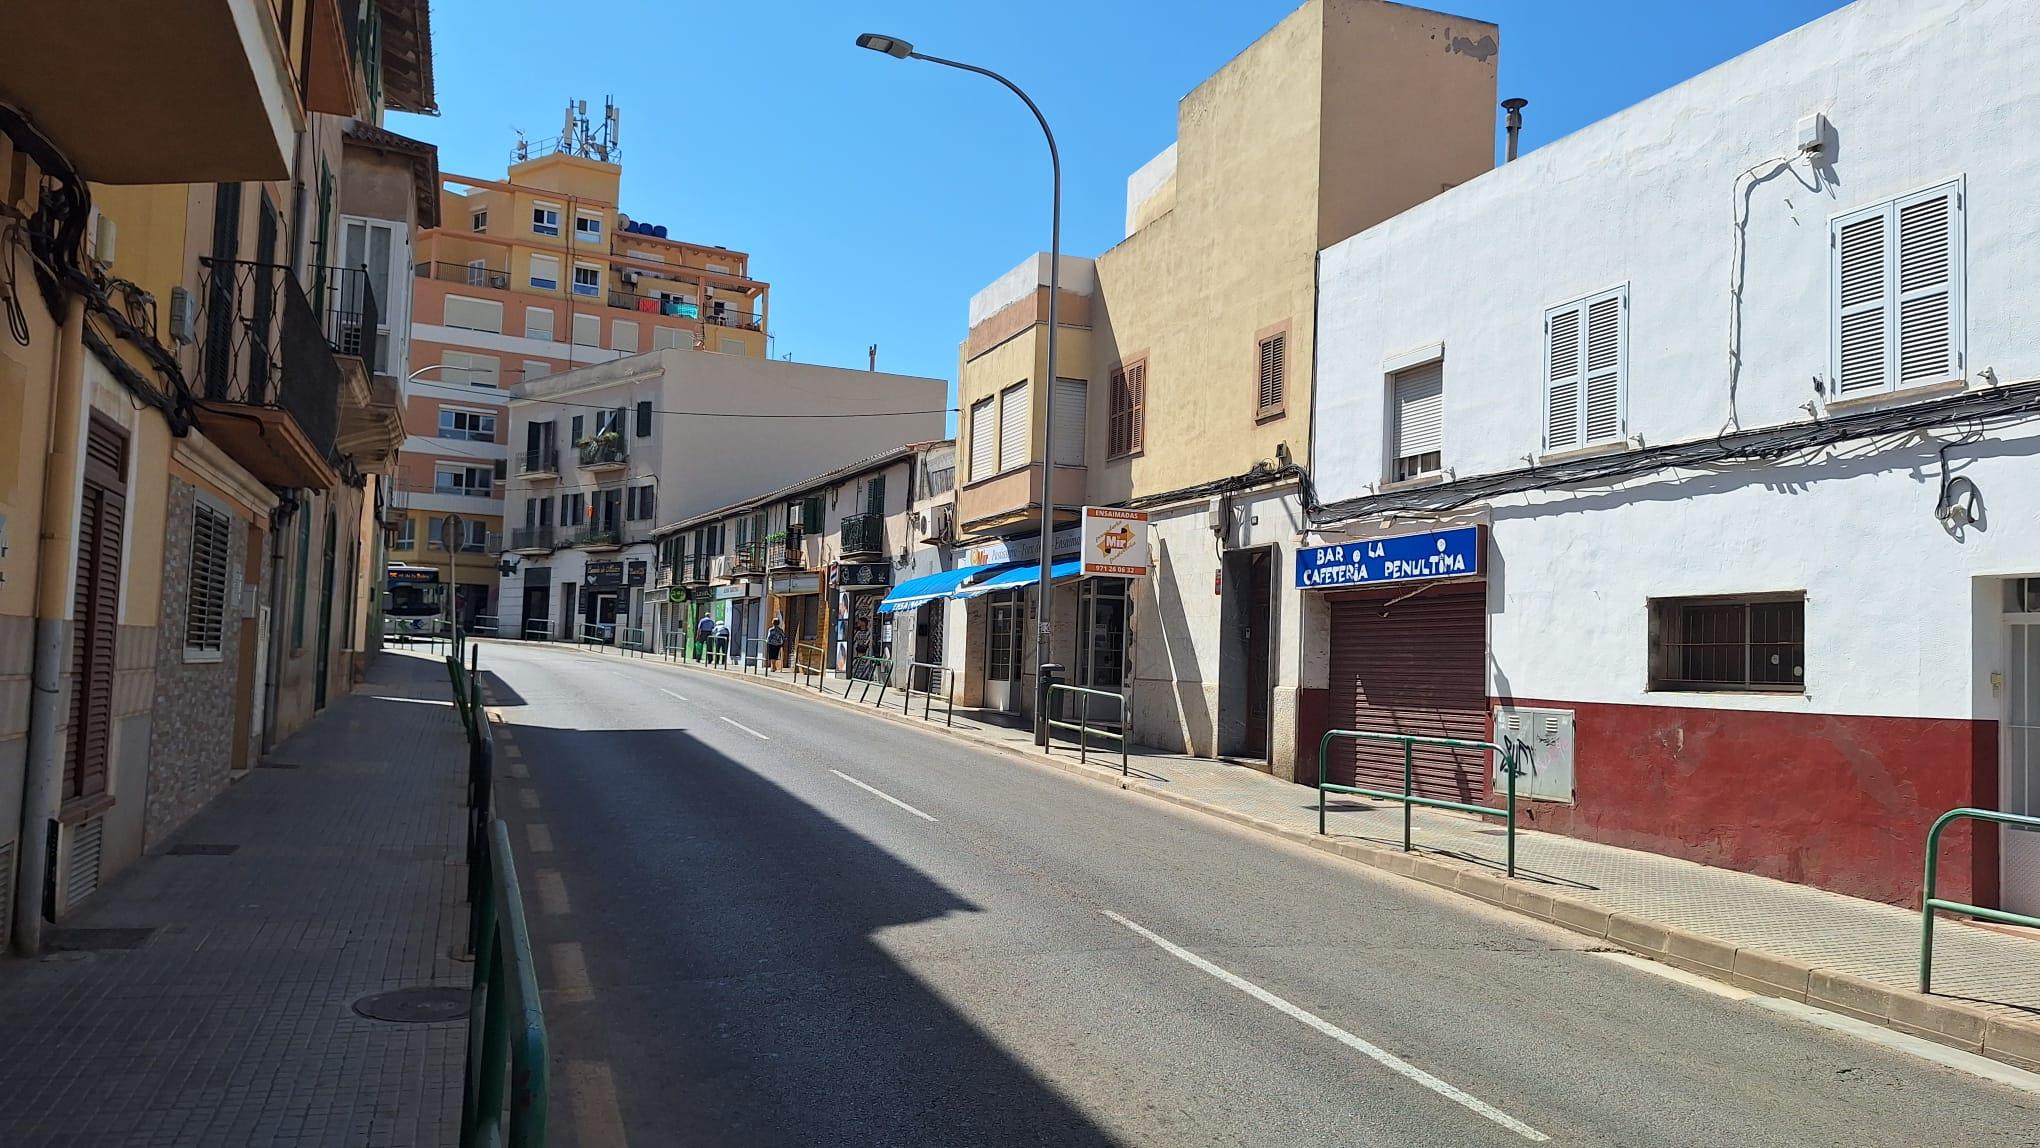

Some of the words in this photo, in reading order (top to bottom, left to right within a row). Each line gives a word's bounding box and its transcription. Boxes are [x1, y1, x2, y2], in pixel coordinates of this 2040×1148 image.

[1095, 509, 1138, 519] ENSAIMADAS
[1316, 546, 1344, 565] BAR
[1368, 542, 1385, 558] LA
